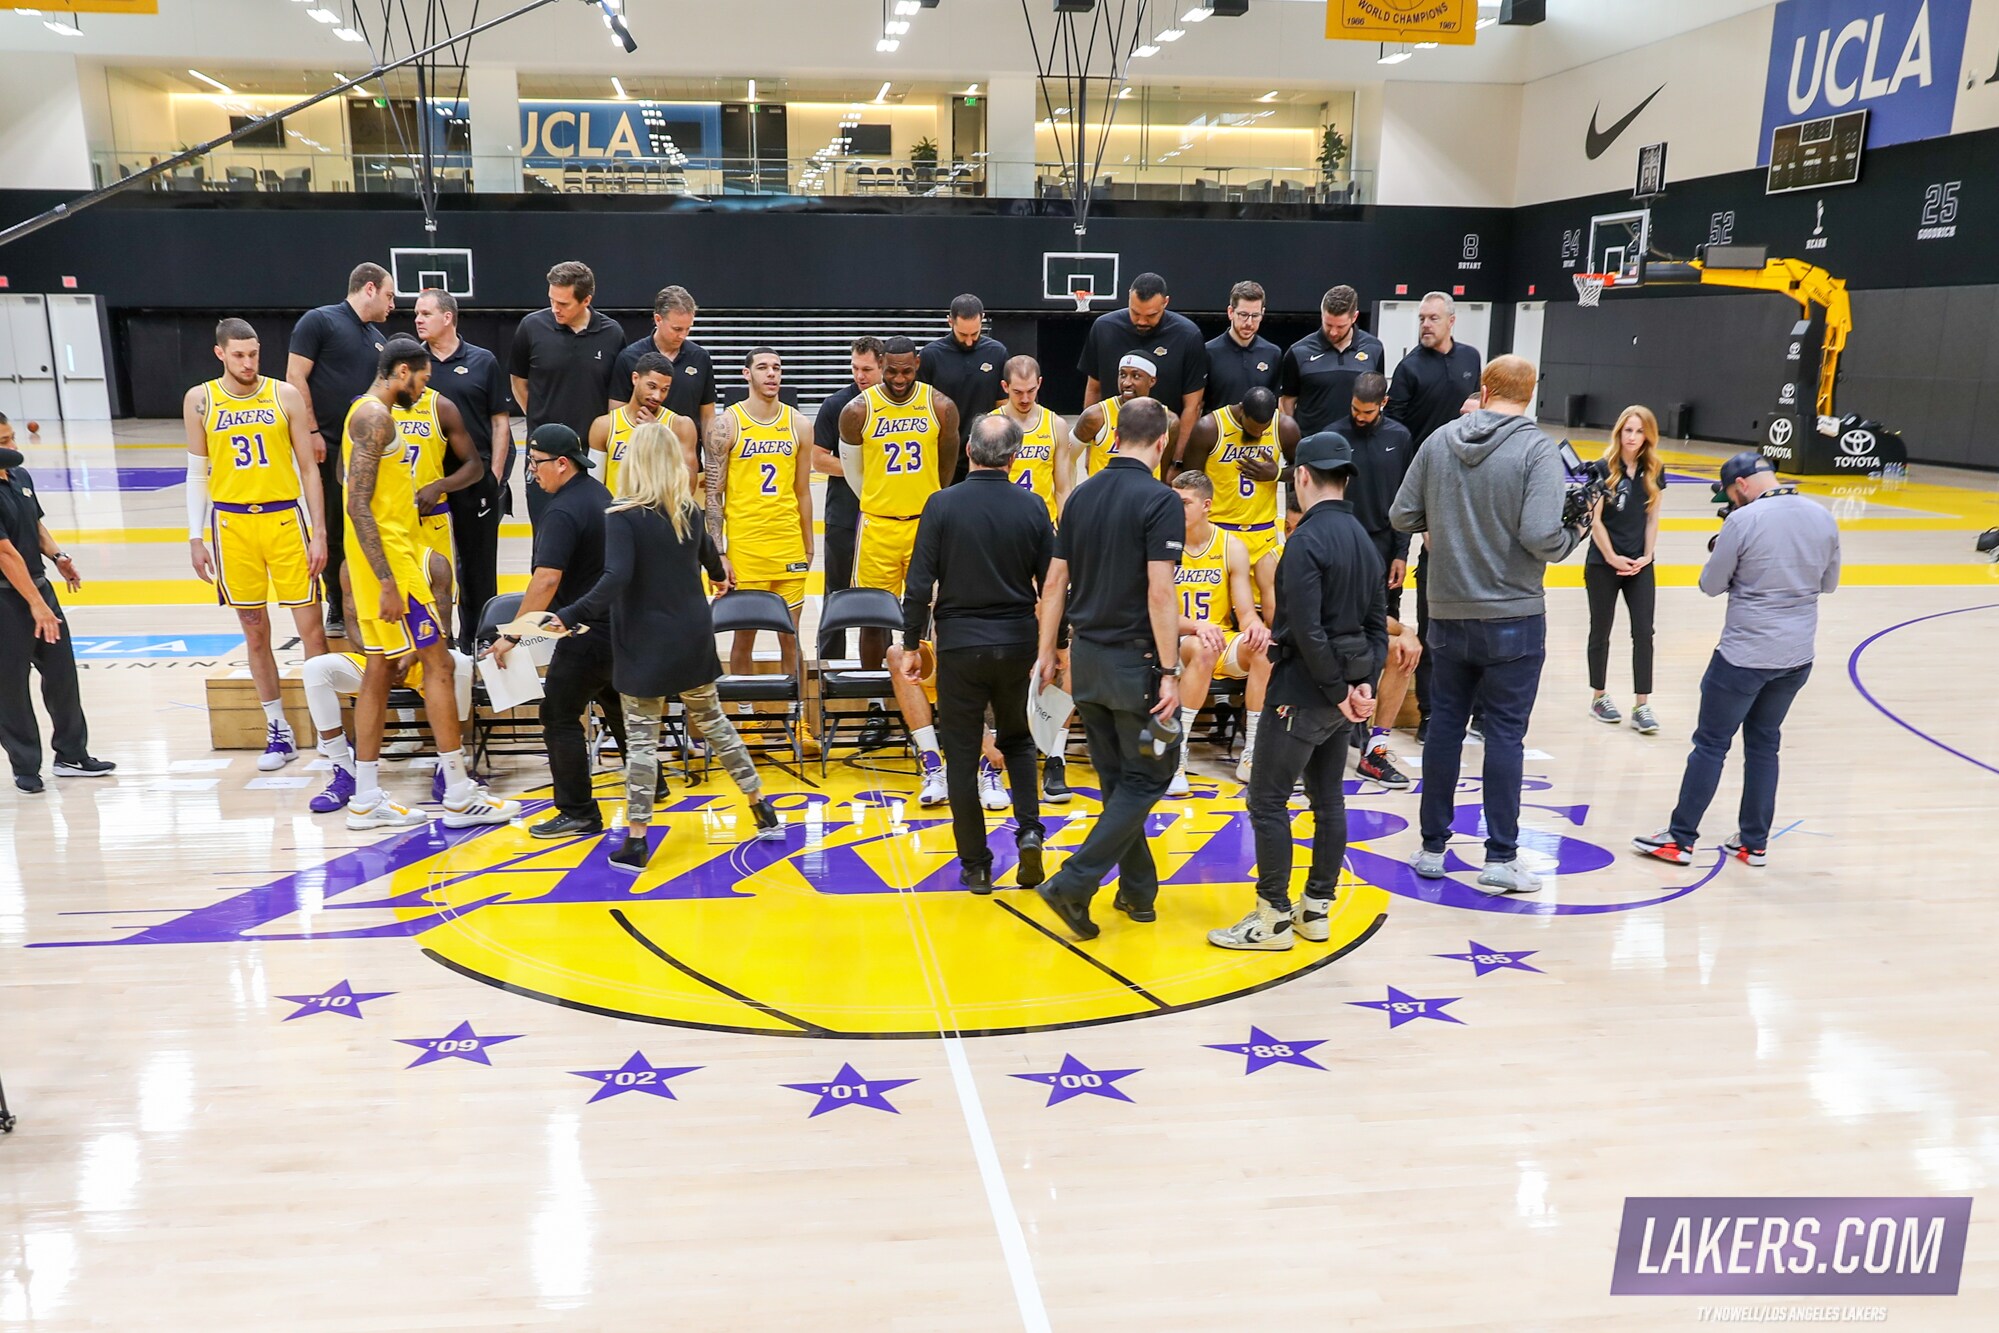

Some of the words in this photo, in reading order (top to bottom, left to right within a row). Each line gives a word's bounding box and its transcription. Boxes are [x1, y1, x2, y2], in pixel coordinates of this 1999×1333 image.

[1358, 0, 1390, 21] WORLD
[1392, 2, 1449, 24] CHAMPIONS
[1787, 0, 1932, 115] UCLA
[1921, 180, 1962, 225] 25
[1709, 210, 1735, 246] 52
[1462, 233, 1480, 260] 8
[213, 408, 276, 432] LAKERS
[396, 421, 431, 437] ERS
[871, 417, 929, 439] LAKERS
[231, 433, 269, 469] 31
[739, 438, 794, 458] LAKERS
[884, 441, 922, 475] 23
[1015, 445, 1051, 461] KERS
[1762, 445, 1792, 459] TOYOTA
[1833, 456, 1881, 468] TOYOTA
[760, 463, 778, 496] 2
[1014, 469, 1033, 491] 4
[1239, 472, 1256, 499] 6
[1183, 591, 1211, 620] 15
[653, 790, 916, 813] LOS
[1465, 954, 1513, 965] '85
[308, 995, 352, 1008] '10
[1382, 1001, 1426, 1014] '87
[428, 1040, 479, 1053] '09
[1241, 1044, 1294, 1058] '88
[604, 1071, 657, 1086] '02
[1048, 1073, 1102, 1088] '00
[821, 1084, 869, 1099] '01
